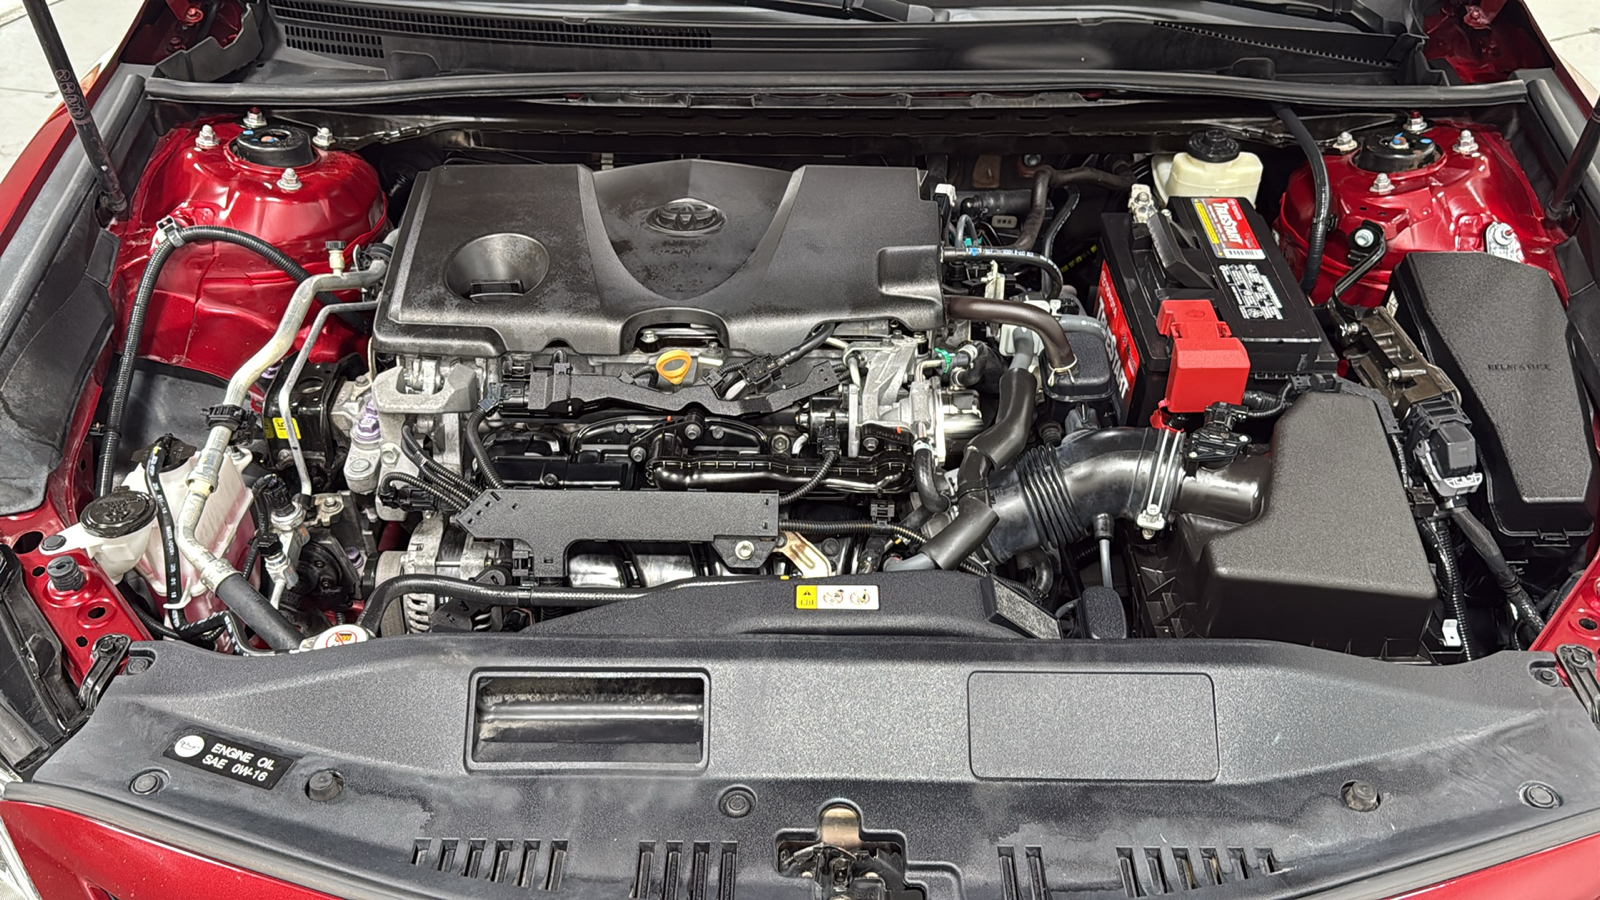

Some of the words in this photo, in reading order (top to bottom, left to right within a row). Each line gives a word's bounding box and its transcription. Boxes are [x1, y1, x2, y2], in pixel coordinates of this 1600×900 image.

[202, 754, 228, 769] SAE
[231, 763, 268, 781] 0W-16
[211, 743, 254, 763] ENGINE
[257, 757, 275, 770] OIL
